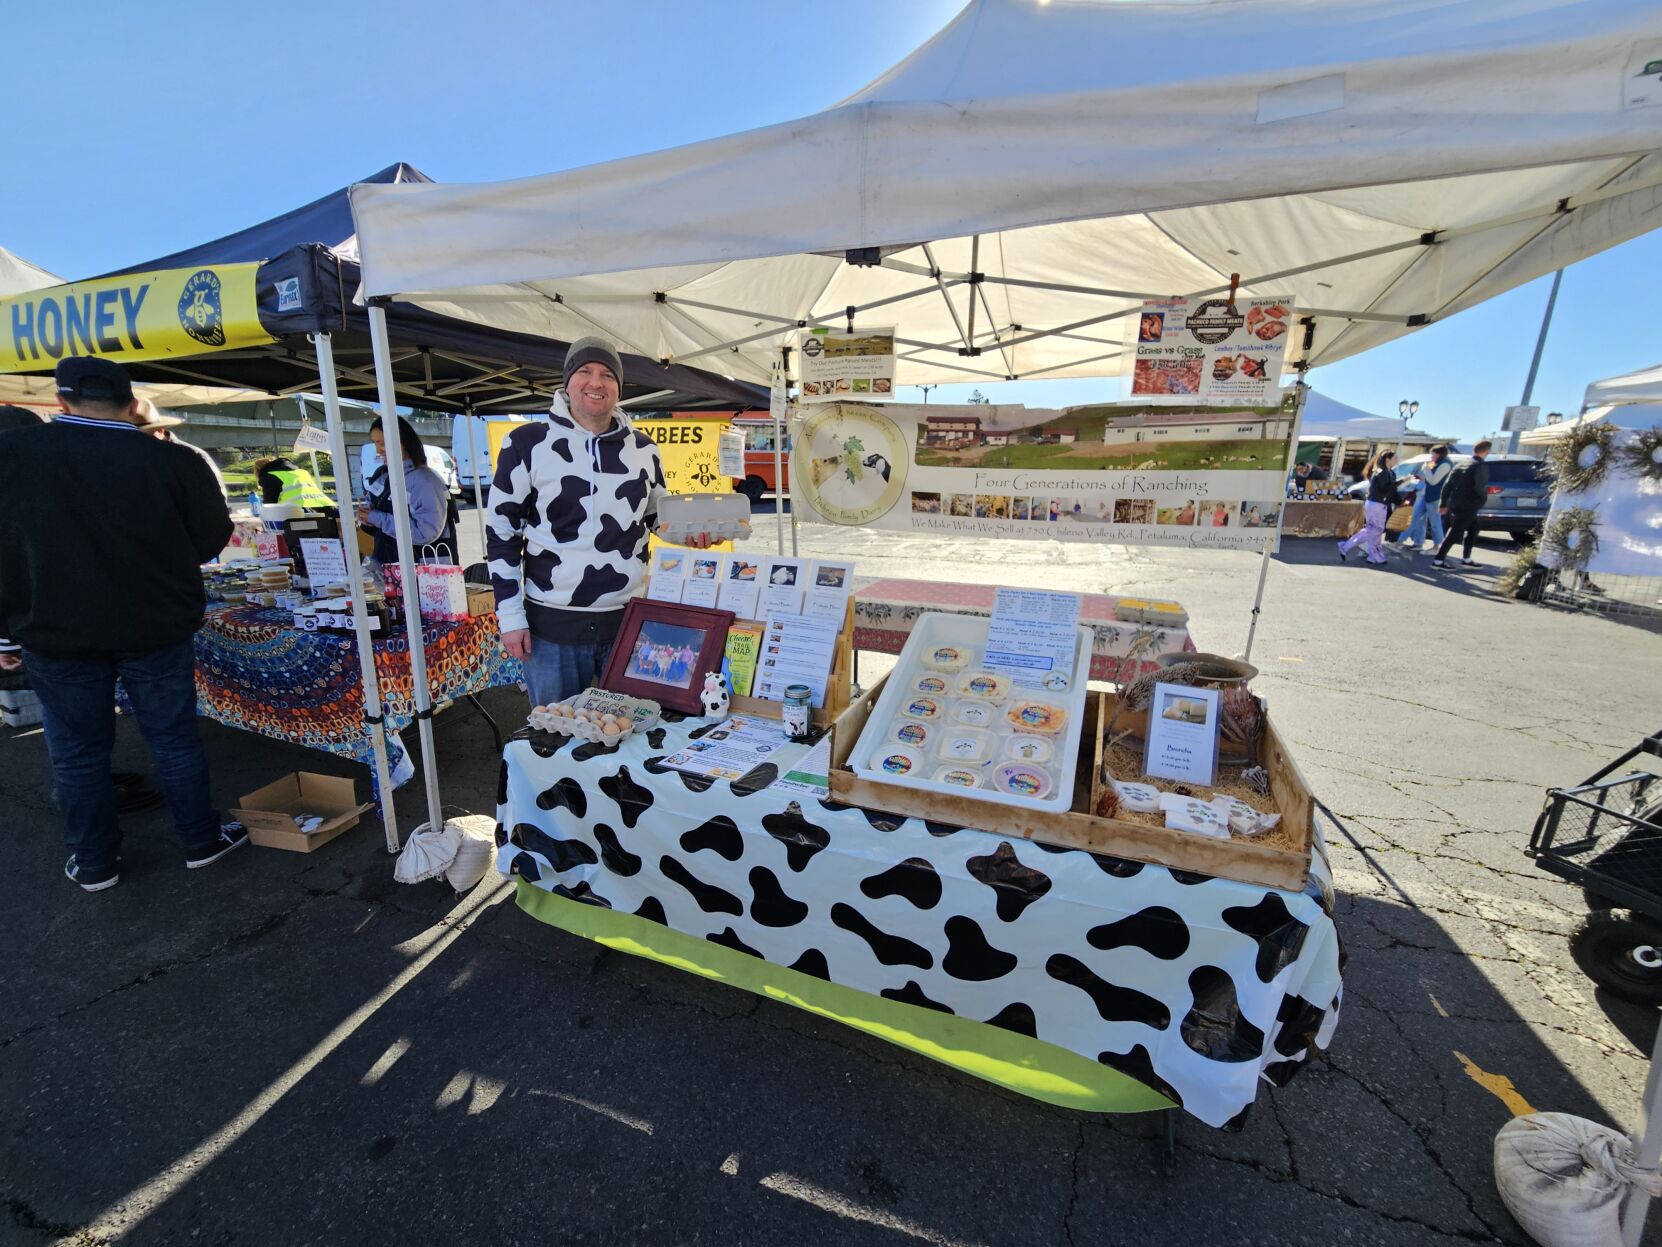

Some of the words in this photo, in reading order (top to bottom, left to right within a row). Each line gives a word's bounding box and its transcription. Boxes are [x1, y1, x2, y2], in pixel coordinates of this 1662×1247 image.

[1277, 298, 1290, 306] Pork
[11, 284, 150, 361] HONEY
[1137, 346, 1162, 355] Grass
[635, 426, 703, 444] YBEES
[975, 472, 1010, 489] Four
[1013, 473, 1106, 491] Generations
[1111, 474, 1130, 490] of
[1132, 475, 1209, 496] Ranching
[911, 518, 926, 528] We
[927, 519, 951, 529] Make
[952, 520, 976, 530] What
[977, 521, 993, 532] We
[996, 523, 1015, 533] Sell
[1086, 527, 1115, 540] Valley
[1190, 531, 1243, 543] California
[733, 647, 751, 656] MAP
[589, 689, 624, 701] PASTURED
